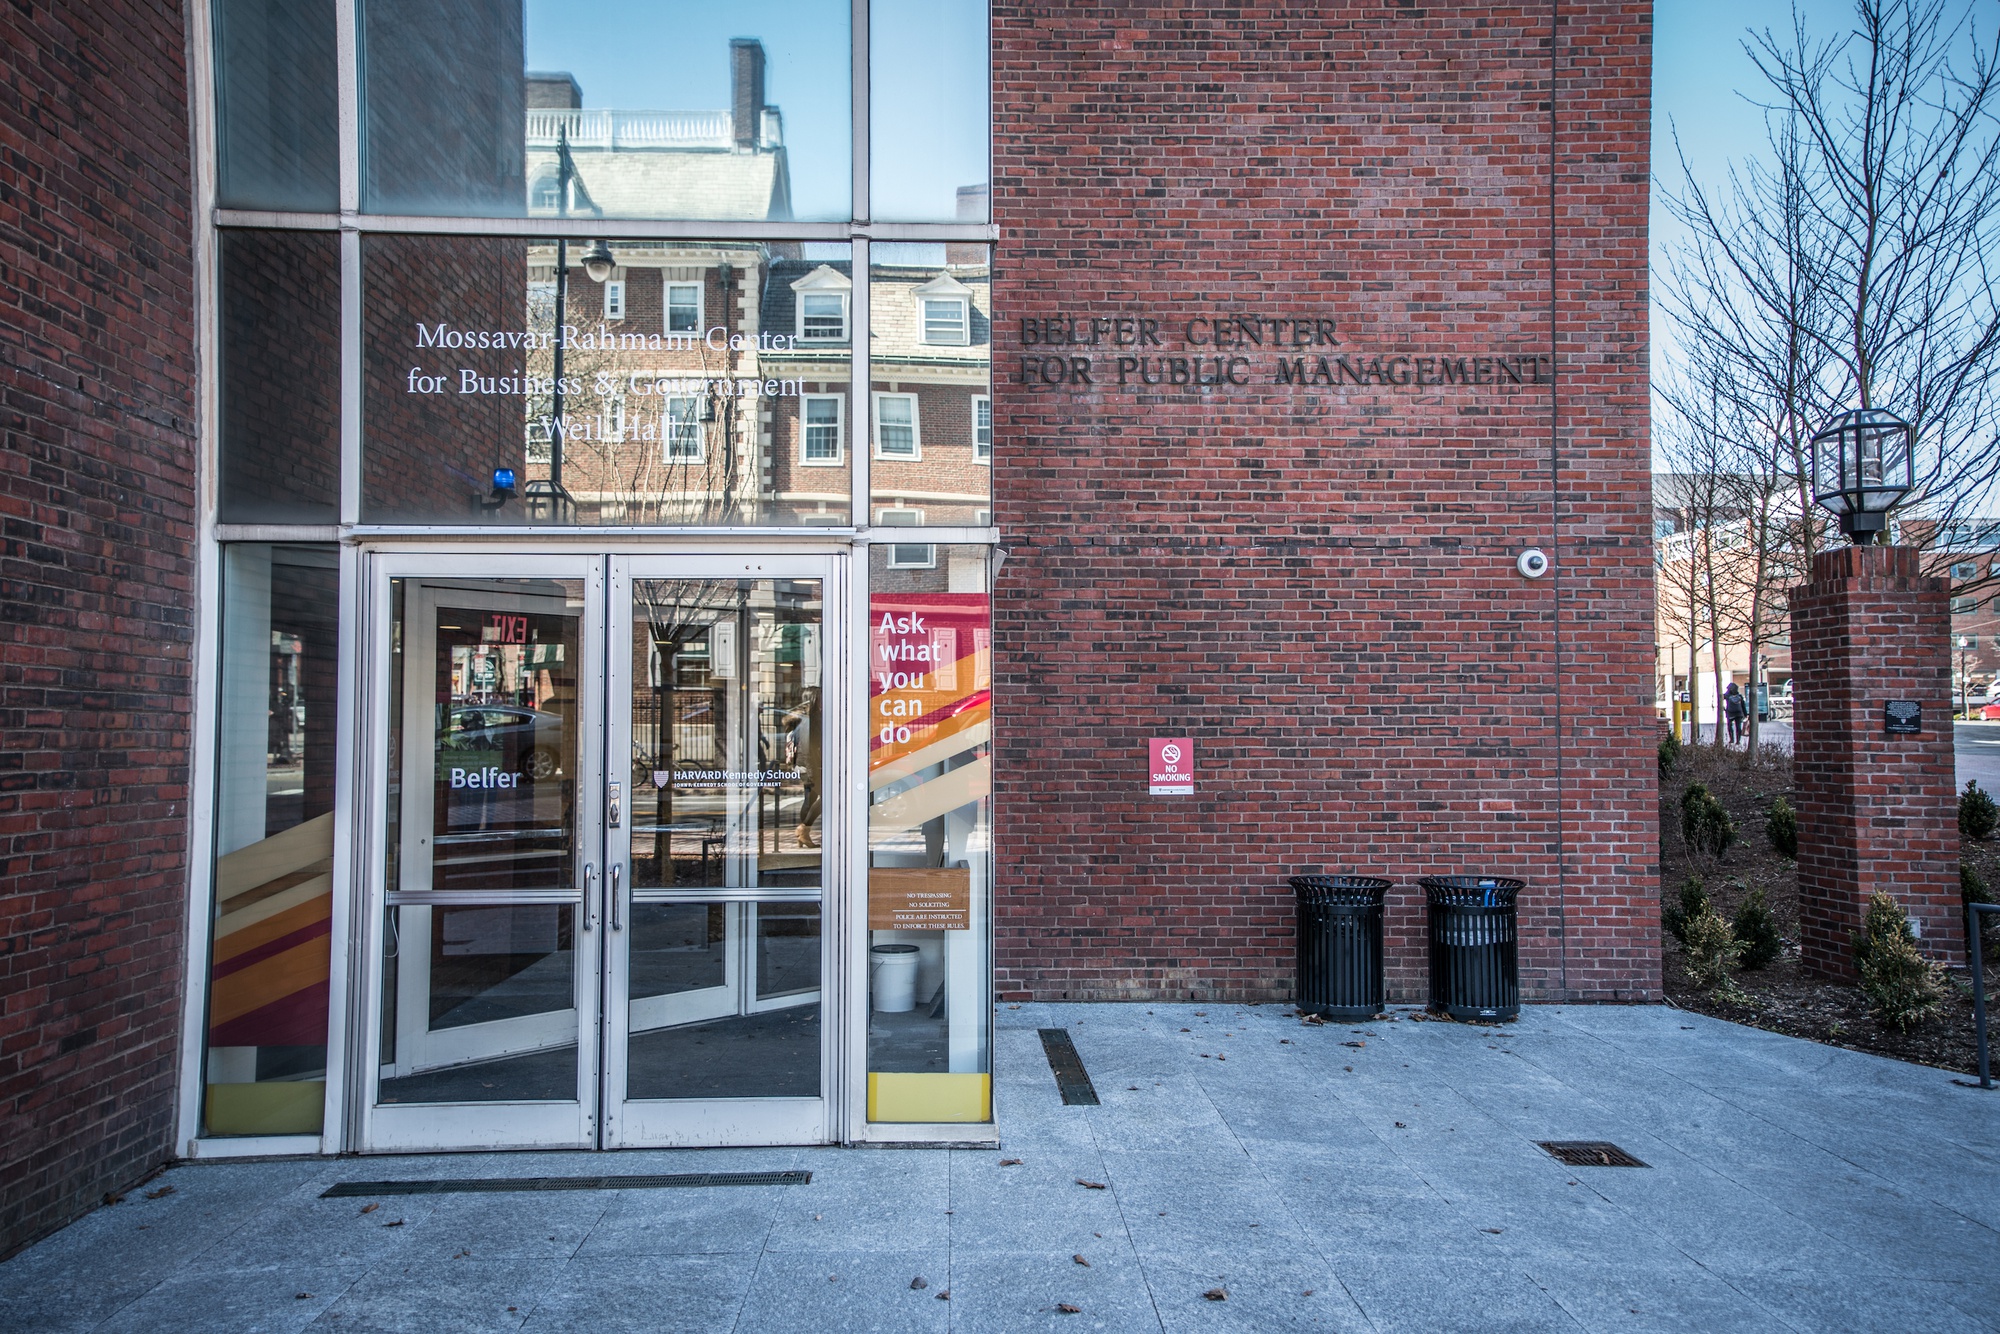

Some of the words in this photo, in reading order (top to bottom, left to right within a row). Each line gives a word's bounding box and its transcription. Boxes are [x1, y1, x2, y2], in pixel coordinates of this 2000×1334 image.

[415, 322, 694, 350] Mossavar-Rahmani
[705, 326, 800, 351] Center
[1020, 317, 1163, 345] BELFER
[1187, 317, 1341, 346] CENTER
[407, 367, 447, 394] for
[459, 369, 582, 396] Business
[594, 371, 619, 396] &
[630, 373, 806, 397] Government
[1020, 356, 1094, 384] FOR
[1117, 356, 1249, 385] PUBLIC
[1275, 356, 1550, 385] MANAGEMENT
[541, 414, 601, 441] Weil
[617, 414, 679, 441] Hall
[878, 611, 926, 634] Ask
[879, 638, 941, 662] what
[879, 671, 924, 694] you
[879, 699, 922, 716] can
[879, 721, 911, 744] do
[451, 766, 522, 789] Belfer
[674, 770, 720, 780] HARVARD
[722, 770, 765, 781] Kennedy
[767, 770, 801, 780] School
[1152, 773, 1191, 782] SMOKING
[1165, 765, 1178, 773] NO
